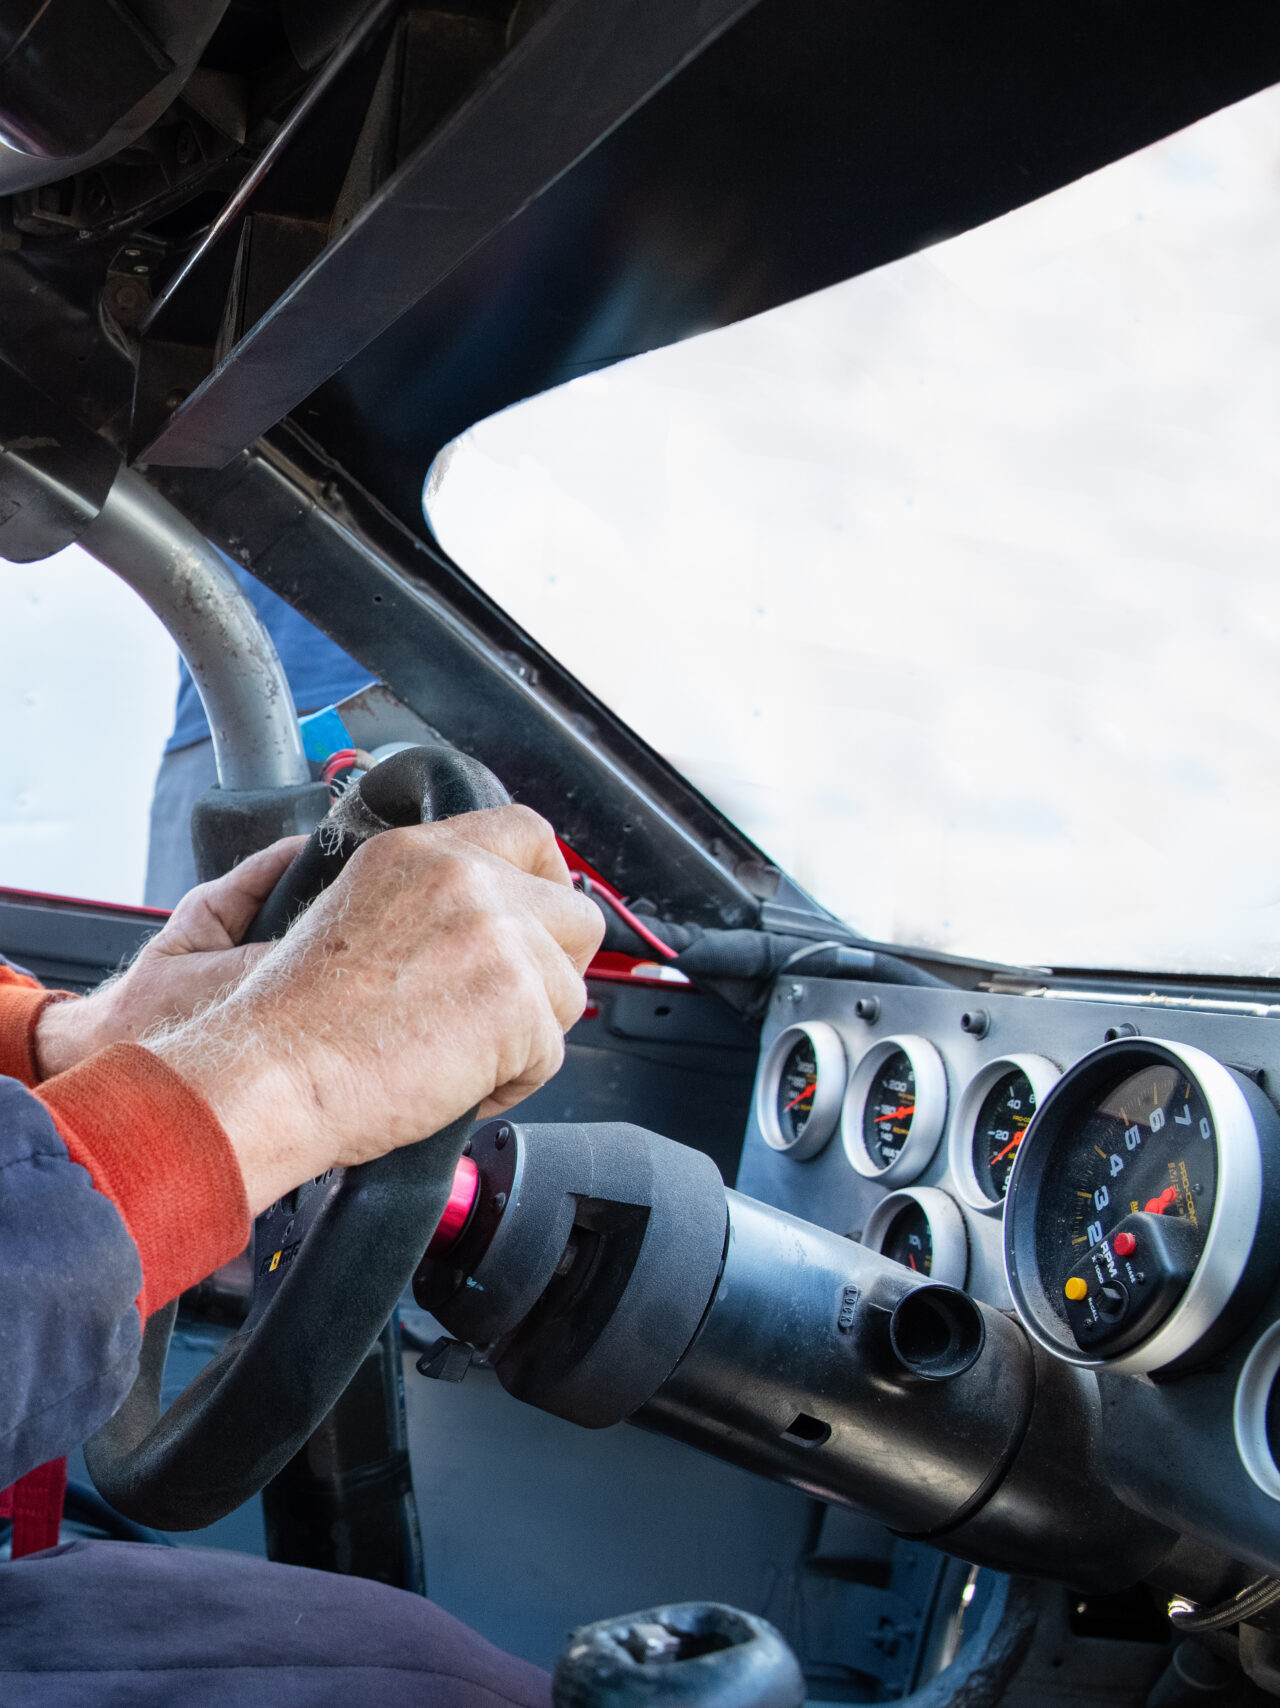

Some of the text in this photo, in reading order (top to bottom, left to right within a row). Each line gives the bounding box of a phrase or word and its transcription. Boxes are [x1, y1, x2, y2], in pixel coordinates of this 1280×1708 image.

[1007, 1099, 1022, 1110] 40
[1174, 1103, 1192, 1126] 7
[1149, 1107, 1166, 1133] 6
[994, 1129, 1010, 1142] 20
[1124, 1124, 1141, 1151] 5
[1109, 1153, 1124, 1178] 4
[1094, 1185, 1110, 1212] 3
[1086, 1220, 1103, 1248] 2
[1100, 1240, 1119, 1278] RPM
